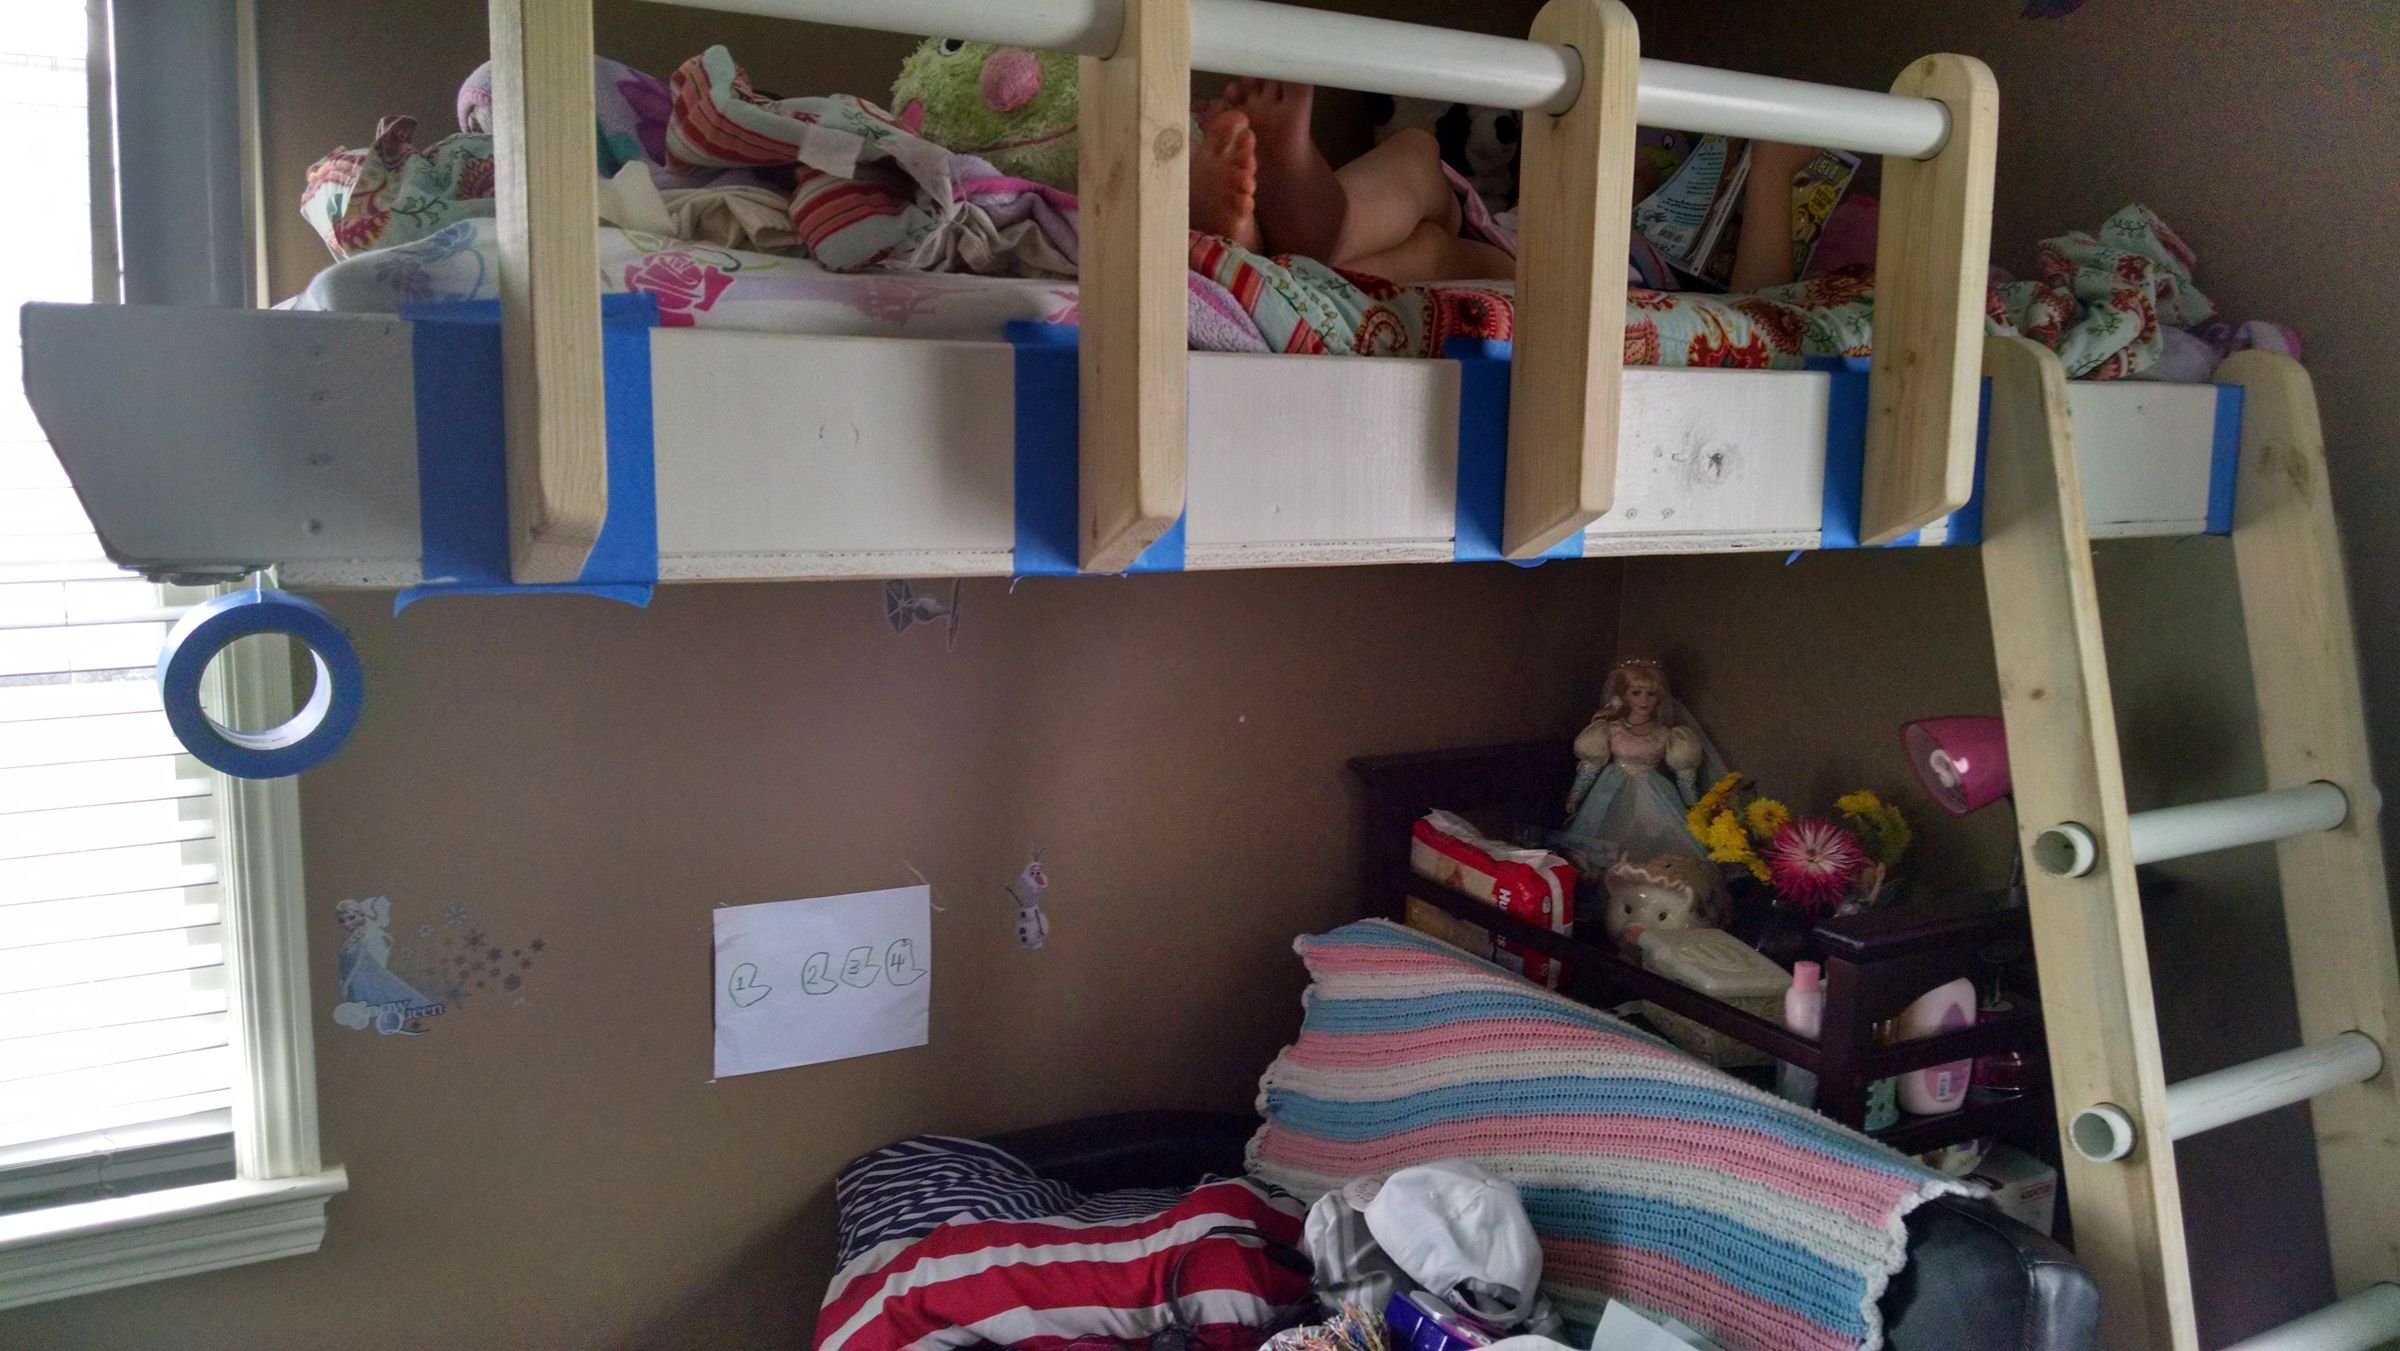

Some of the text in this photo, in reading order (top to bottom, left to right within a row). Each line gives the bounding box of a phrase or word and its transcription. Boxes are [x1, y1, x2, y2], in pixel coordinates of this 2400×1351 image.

[735, 953, 905, 991] 1 2 3 4
